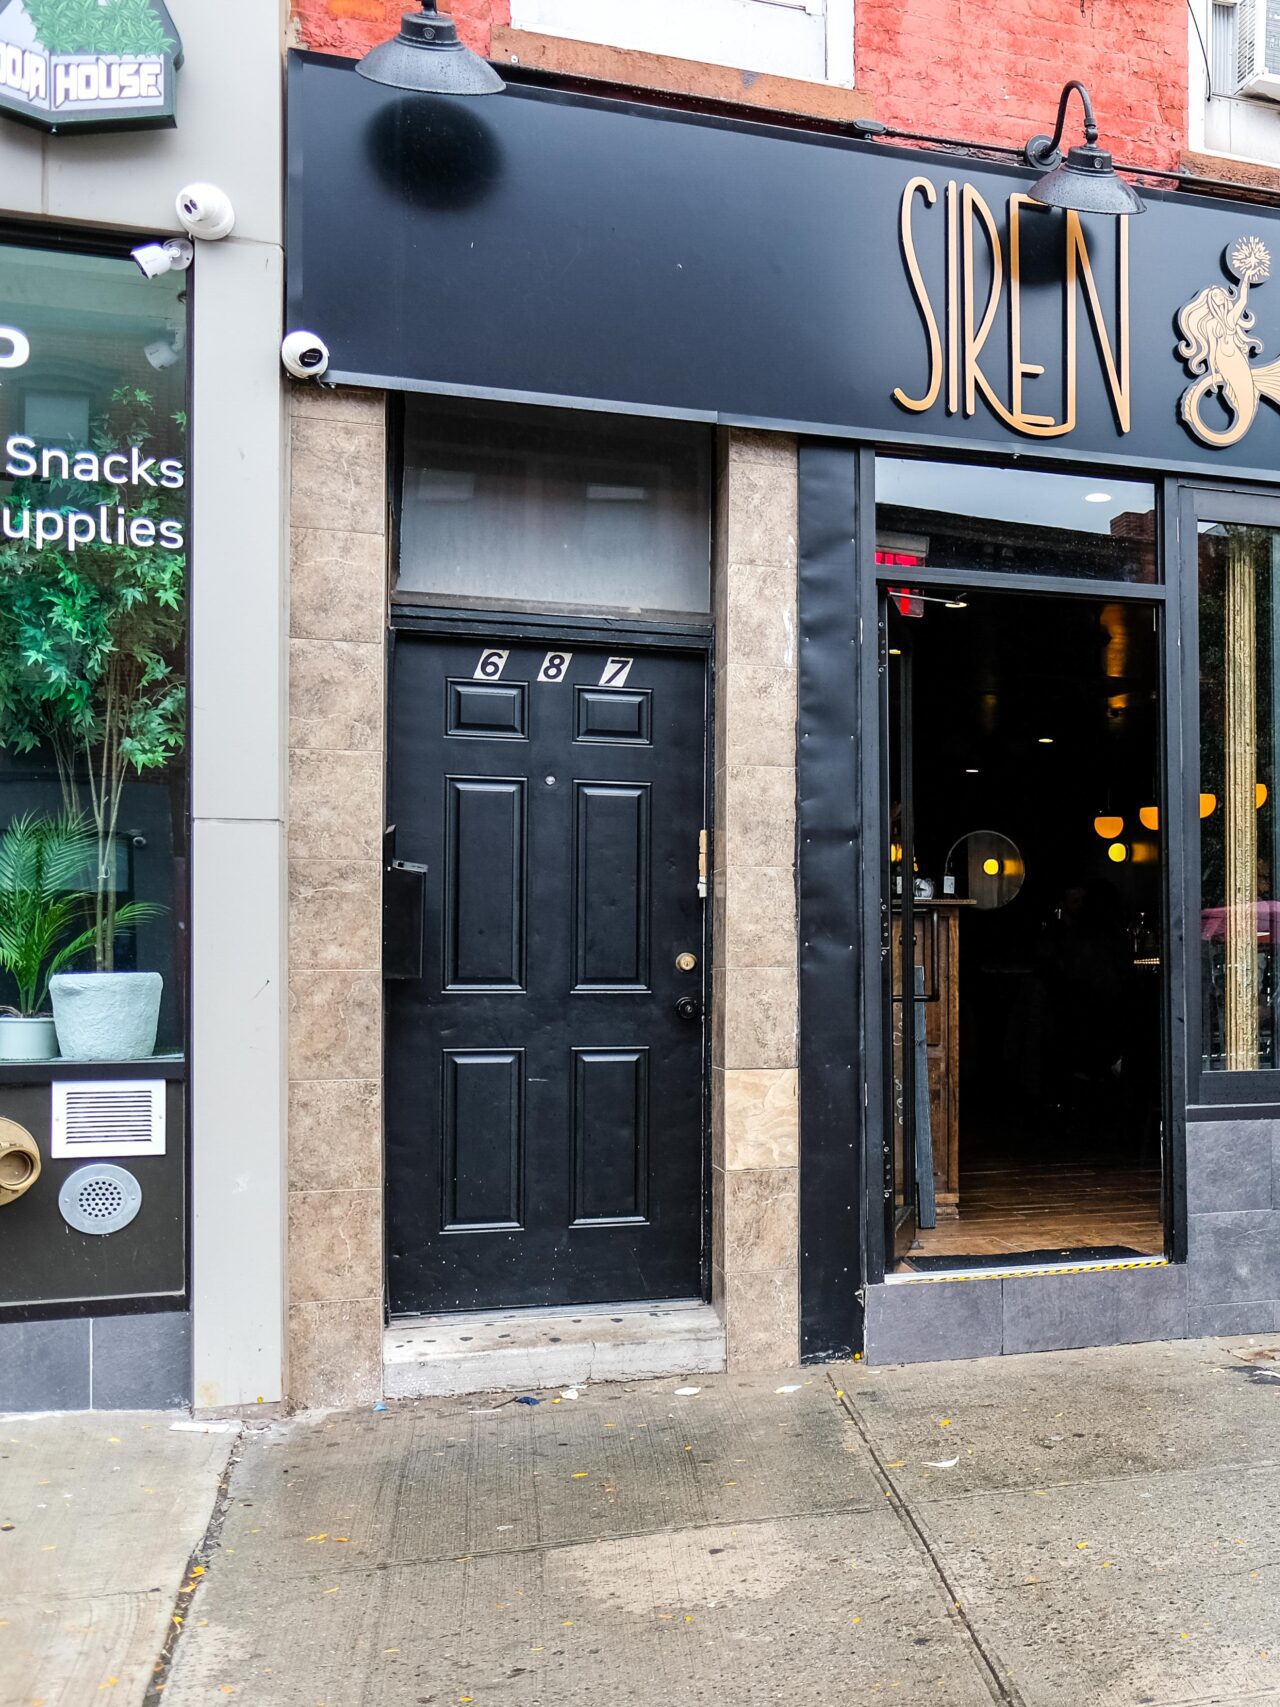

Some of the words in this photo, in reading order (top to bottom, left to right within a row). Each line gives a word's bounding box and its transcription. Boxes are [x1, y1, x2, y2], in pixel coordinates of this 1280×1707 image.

[0, 42, 46, 101] OJA
[55, 57, 162, 109] HOUSE
[894, 176, 1130, 436] SIREN
[6, 435, 184, 488] Snacks
